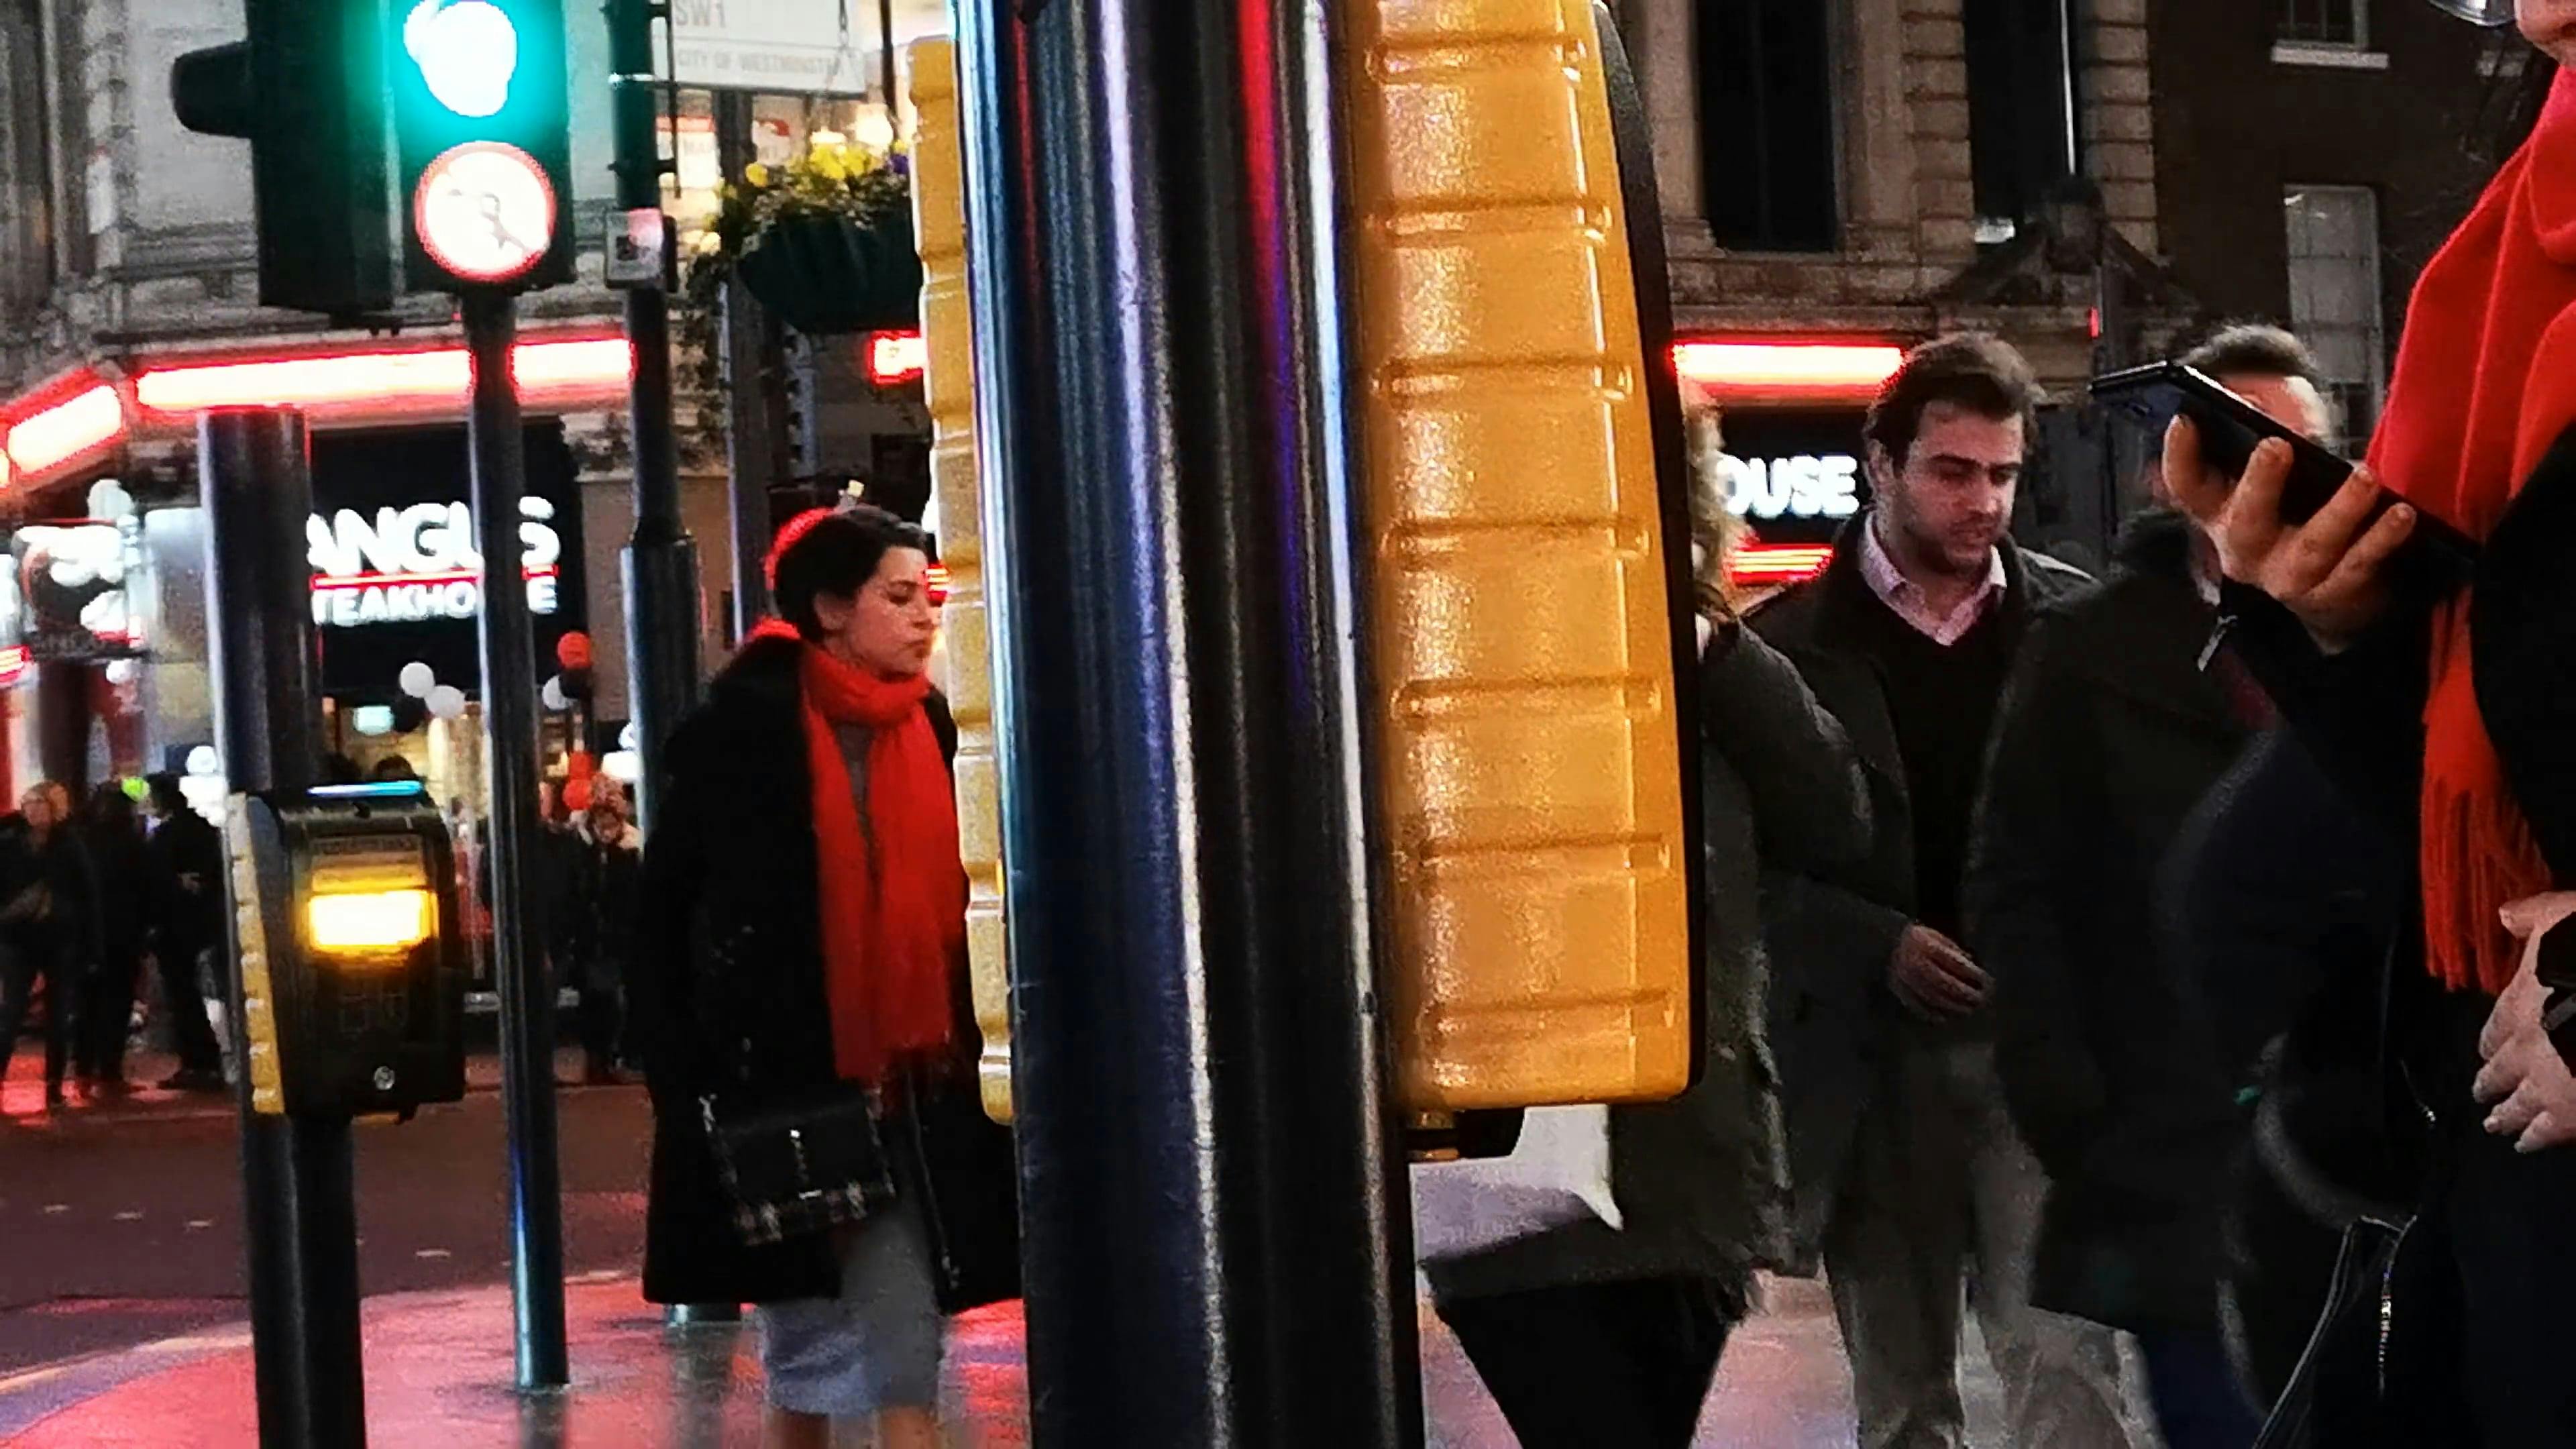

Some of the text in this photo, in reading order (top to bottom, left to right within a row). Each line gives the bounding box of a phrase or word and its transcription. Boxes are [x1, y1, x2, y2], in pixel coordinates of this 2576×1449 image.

[676, 0, 726, 28] SW1
[678, 46, 708, 66] CITY
[712, 49, 732, 70] OF
